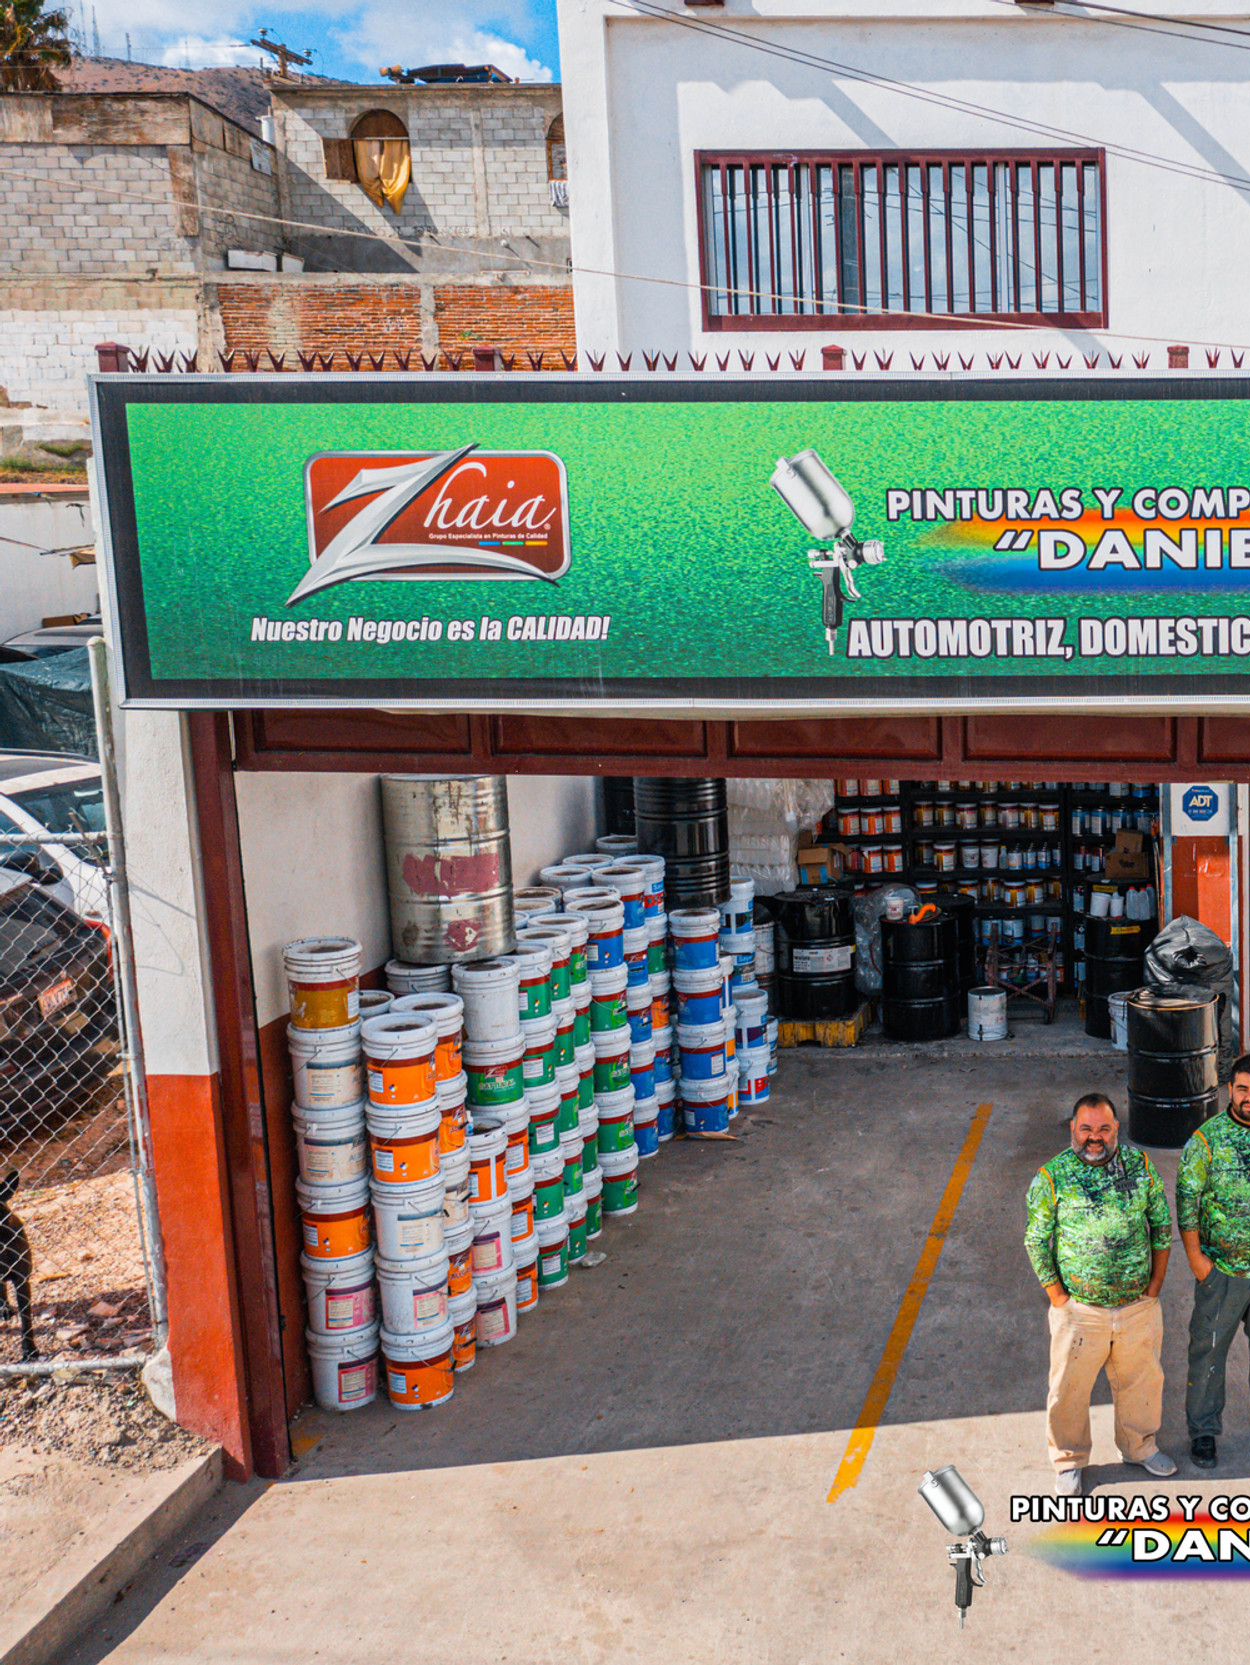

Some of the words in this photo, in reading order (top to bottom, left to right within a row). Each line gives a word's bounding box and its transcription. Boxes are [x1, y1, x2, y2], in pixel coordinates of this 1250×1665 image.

[887, 489, 1083, 521] PINTURAS
[1093, 488, 1123, 520] Y
[428, 532, 447, 540] Grupo
[250, 617, 343, 642] Nuestro
[347, 617, 444, 644] Negocio
[447, 622, 473, 641] es
[477, 616, 502, 640] la
[507, 616, 612, 641] CALIDAD!
[848, 619, 1072, 660] AUTOMOTRIZ,
[1189, 795, 1212, 807] ADT
